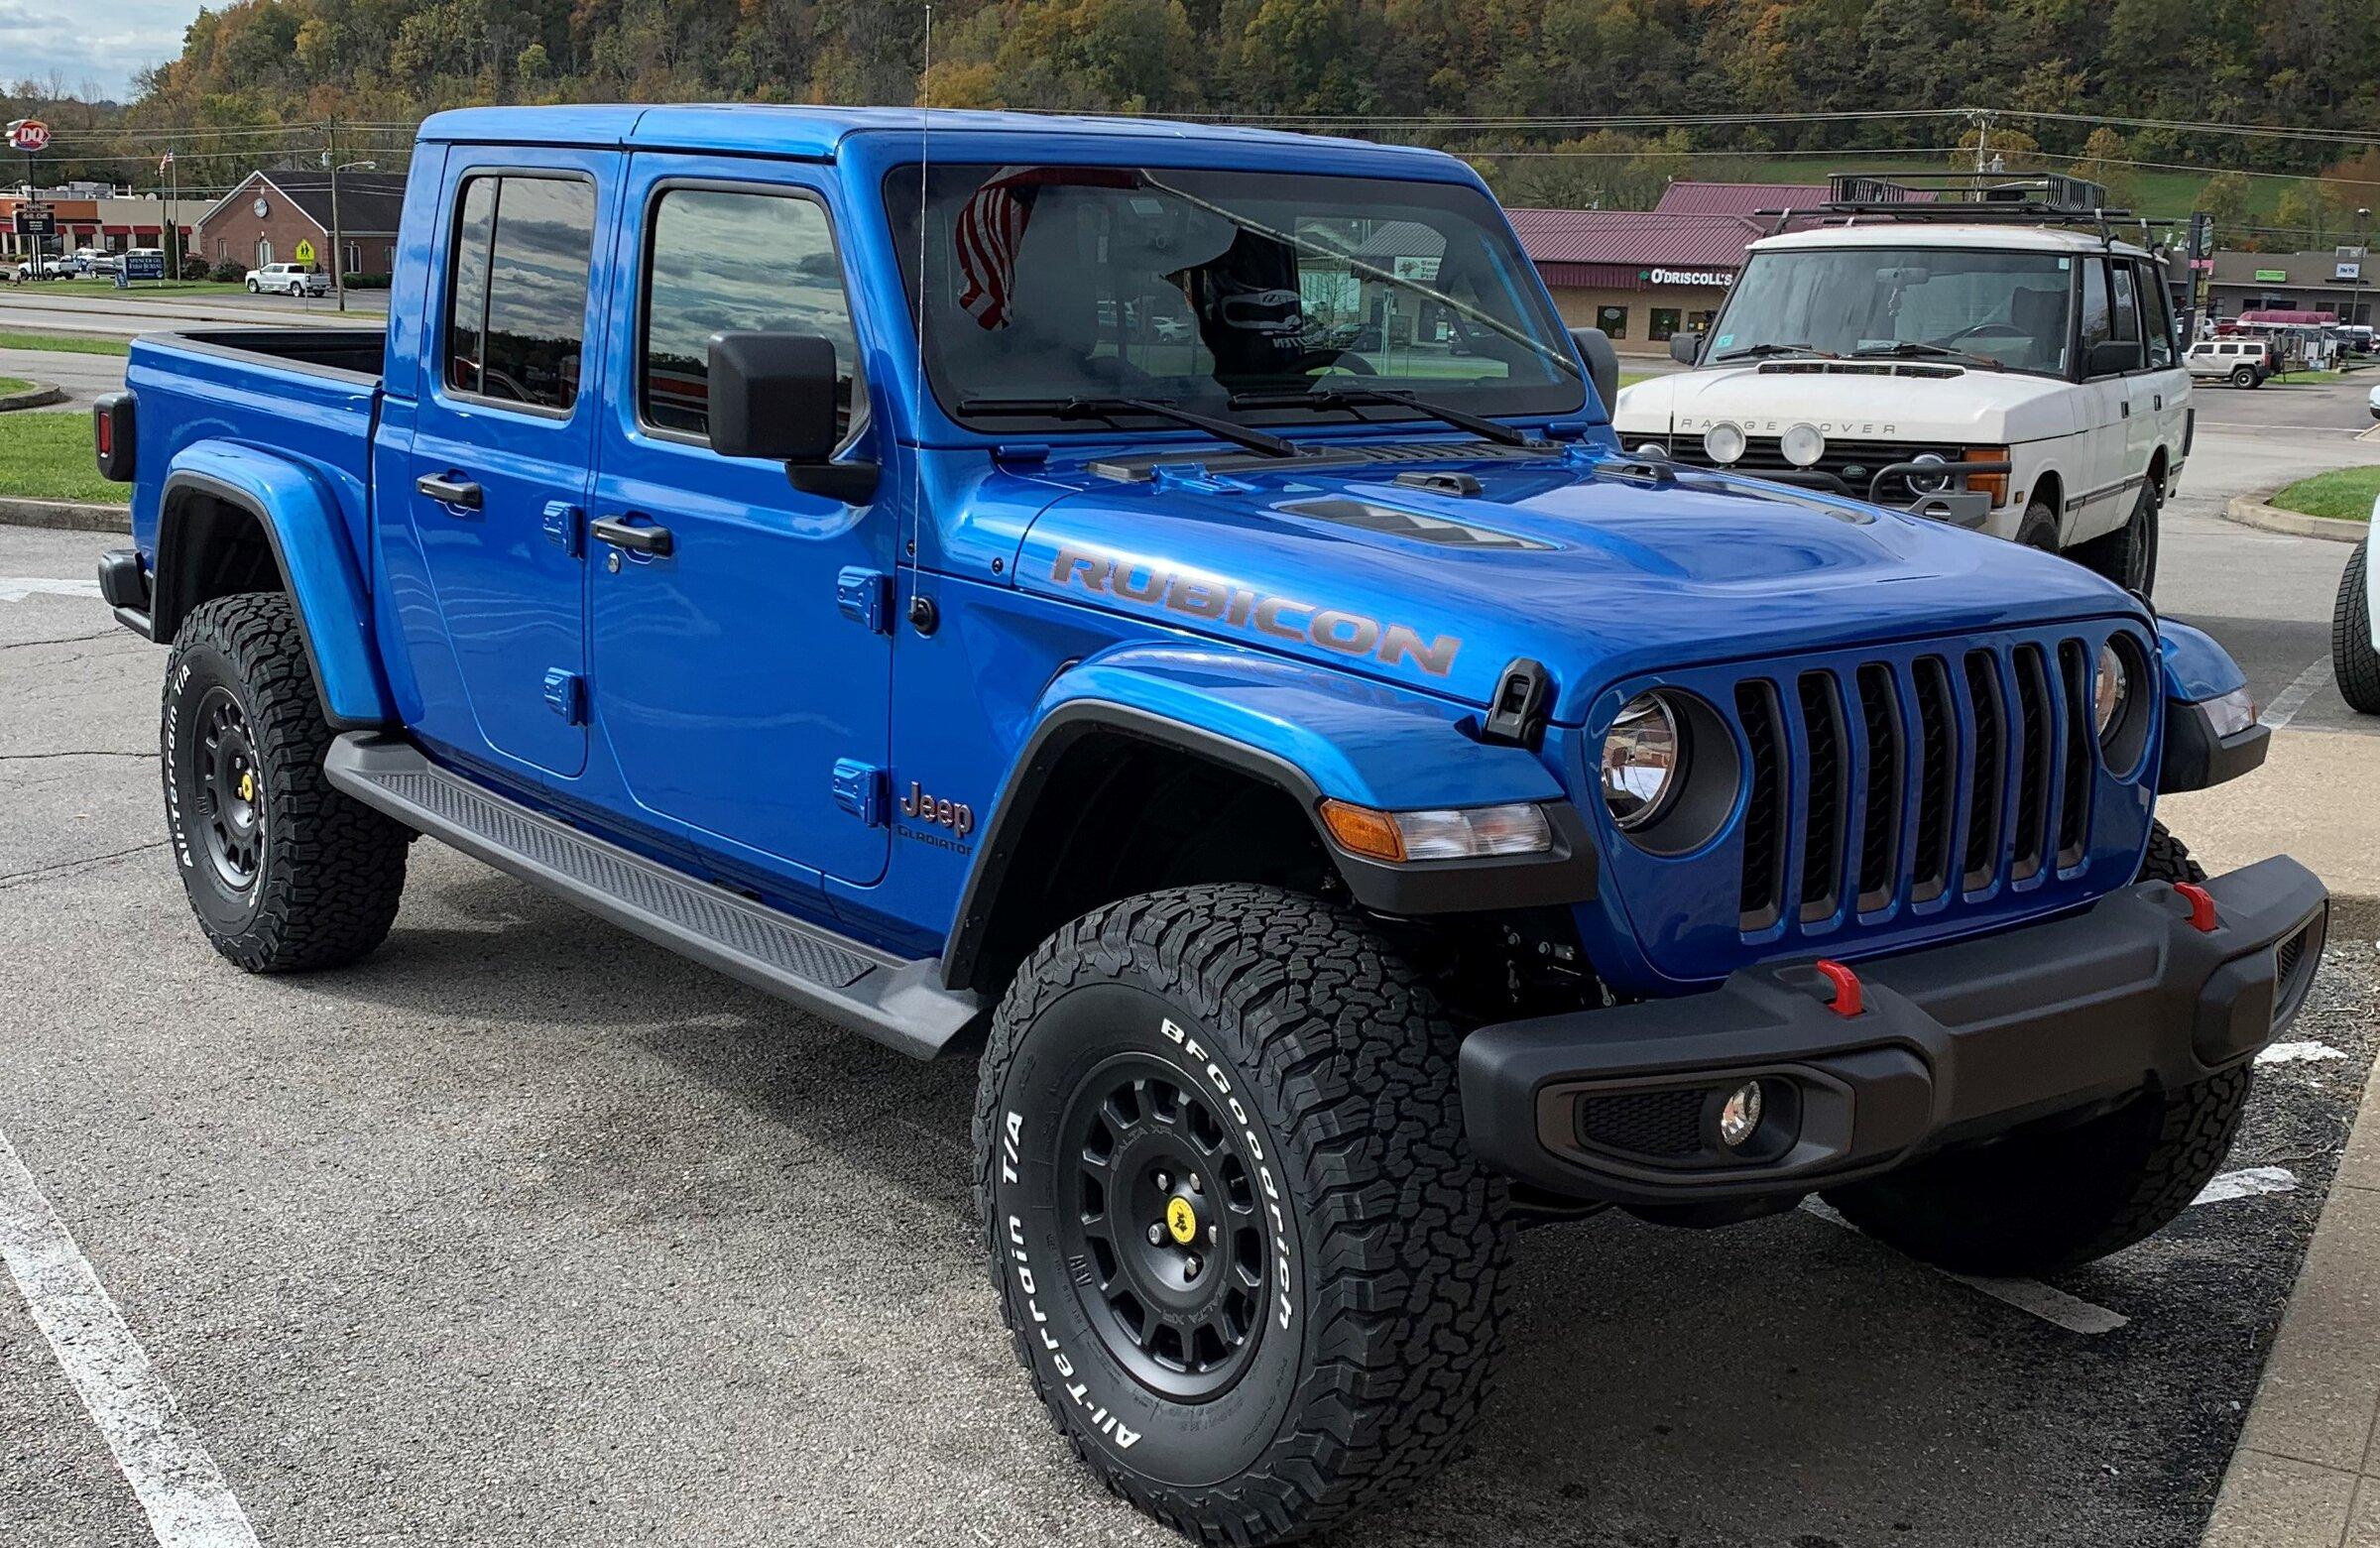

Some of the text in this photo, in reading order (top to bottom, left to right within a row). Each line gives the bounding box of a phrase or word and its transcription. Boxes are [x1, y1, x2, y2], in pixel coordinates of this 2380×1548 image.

[20, 127, 45, 143] DQ
[1651, 269, 1732, 286] O'DRISCOLL'S
[1681, 418, 1896, 434] RAGE OVER
[1051, 546, 1463, 678] RUBICON
[174, 664, 191, 695] T/A
[900, 780, 973, 839] Jeep
[1003, 1111, 1023, 1184] T/A
[1161, 1017, 1291, 1330] BFGoodrich
[1010, 1215, 1141, 1449] All-Terrain
